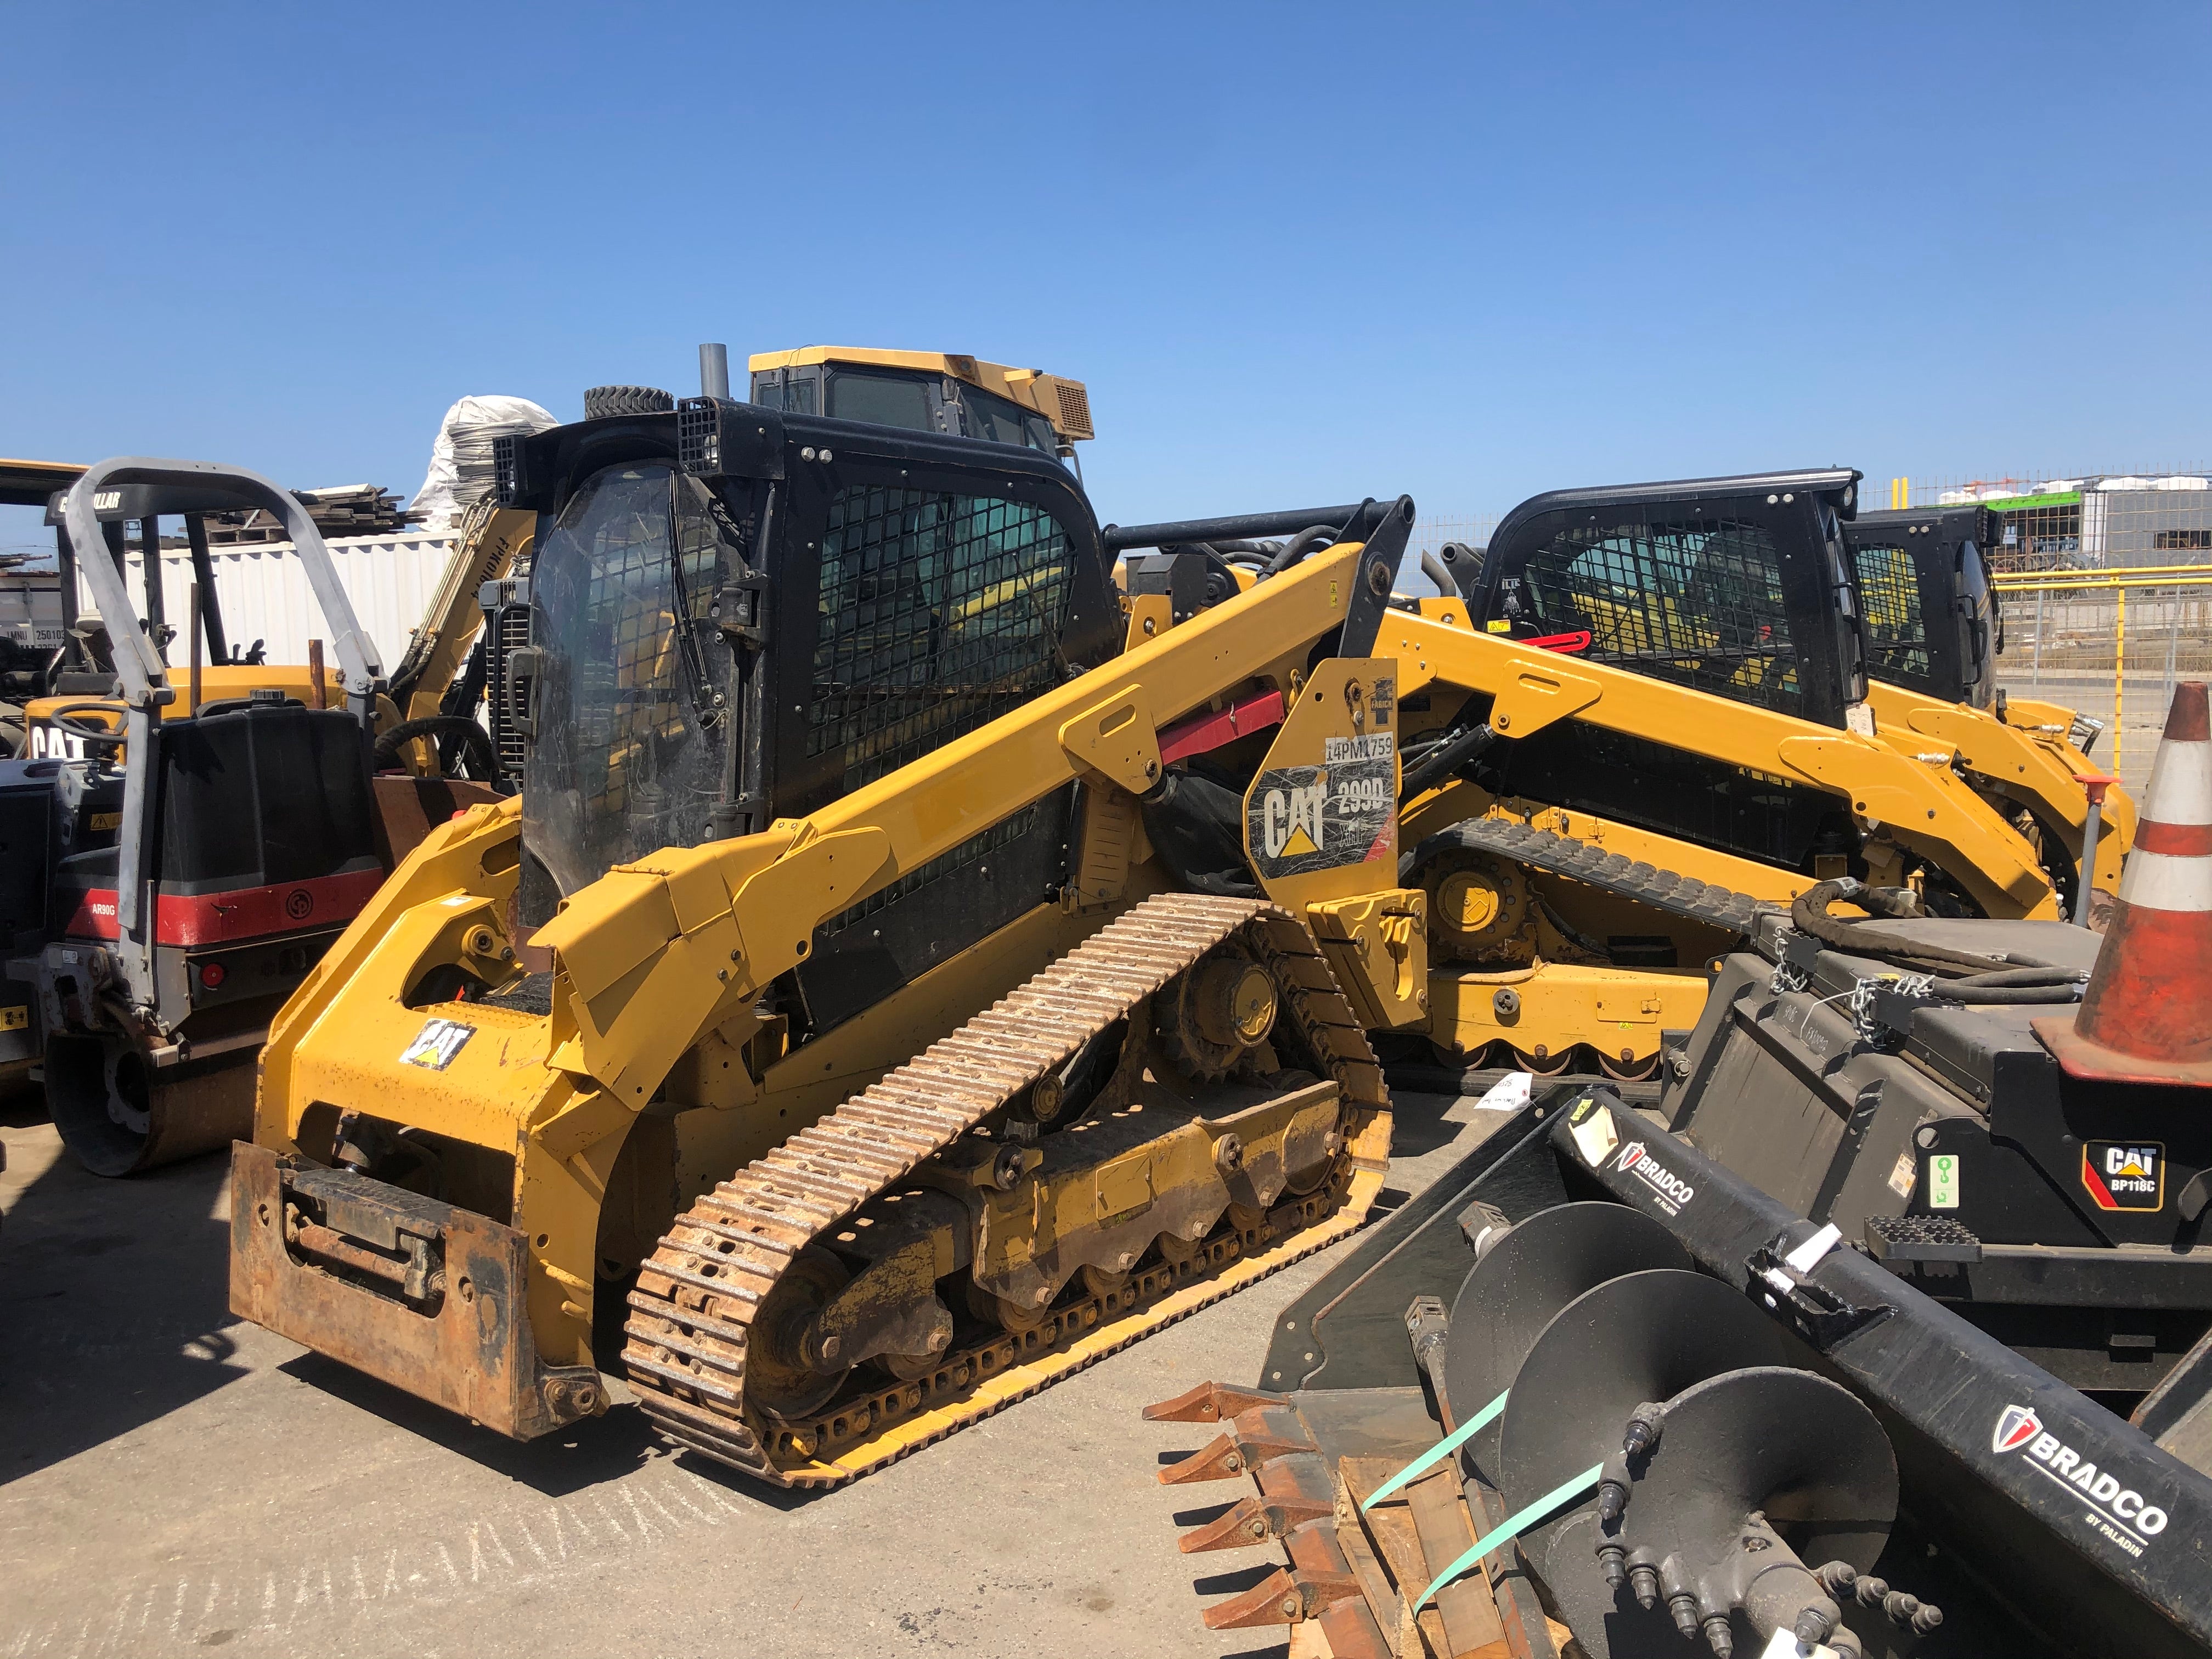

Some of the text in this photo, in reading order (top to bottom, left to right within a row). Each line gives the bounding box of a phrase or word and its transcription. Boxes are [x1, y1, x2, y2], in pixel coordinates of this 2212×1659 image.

[59, 491, 121, 512] CILLAR
[1339, 778, 1384, 814] 299D
[1264, 784, 1327, 859] CAT
[92, 903, 115, 916] AR90G
[403, 1020, 470, 1065] CAT
[1636, 1155, 1694, 1203] BRADCO
[2107, 1147, 2157, 1176] CAT
[2112, 1180, 2155, 1192] BP118C
[1654, 1196, 1678, 1217] BY PALADIN
[2029, 1432, 2168, 1535] BRADCO
[2086, 1513, 2144, 1558] BY PALADIN
